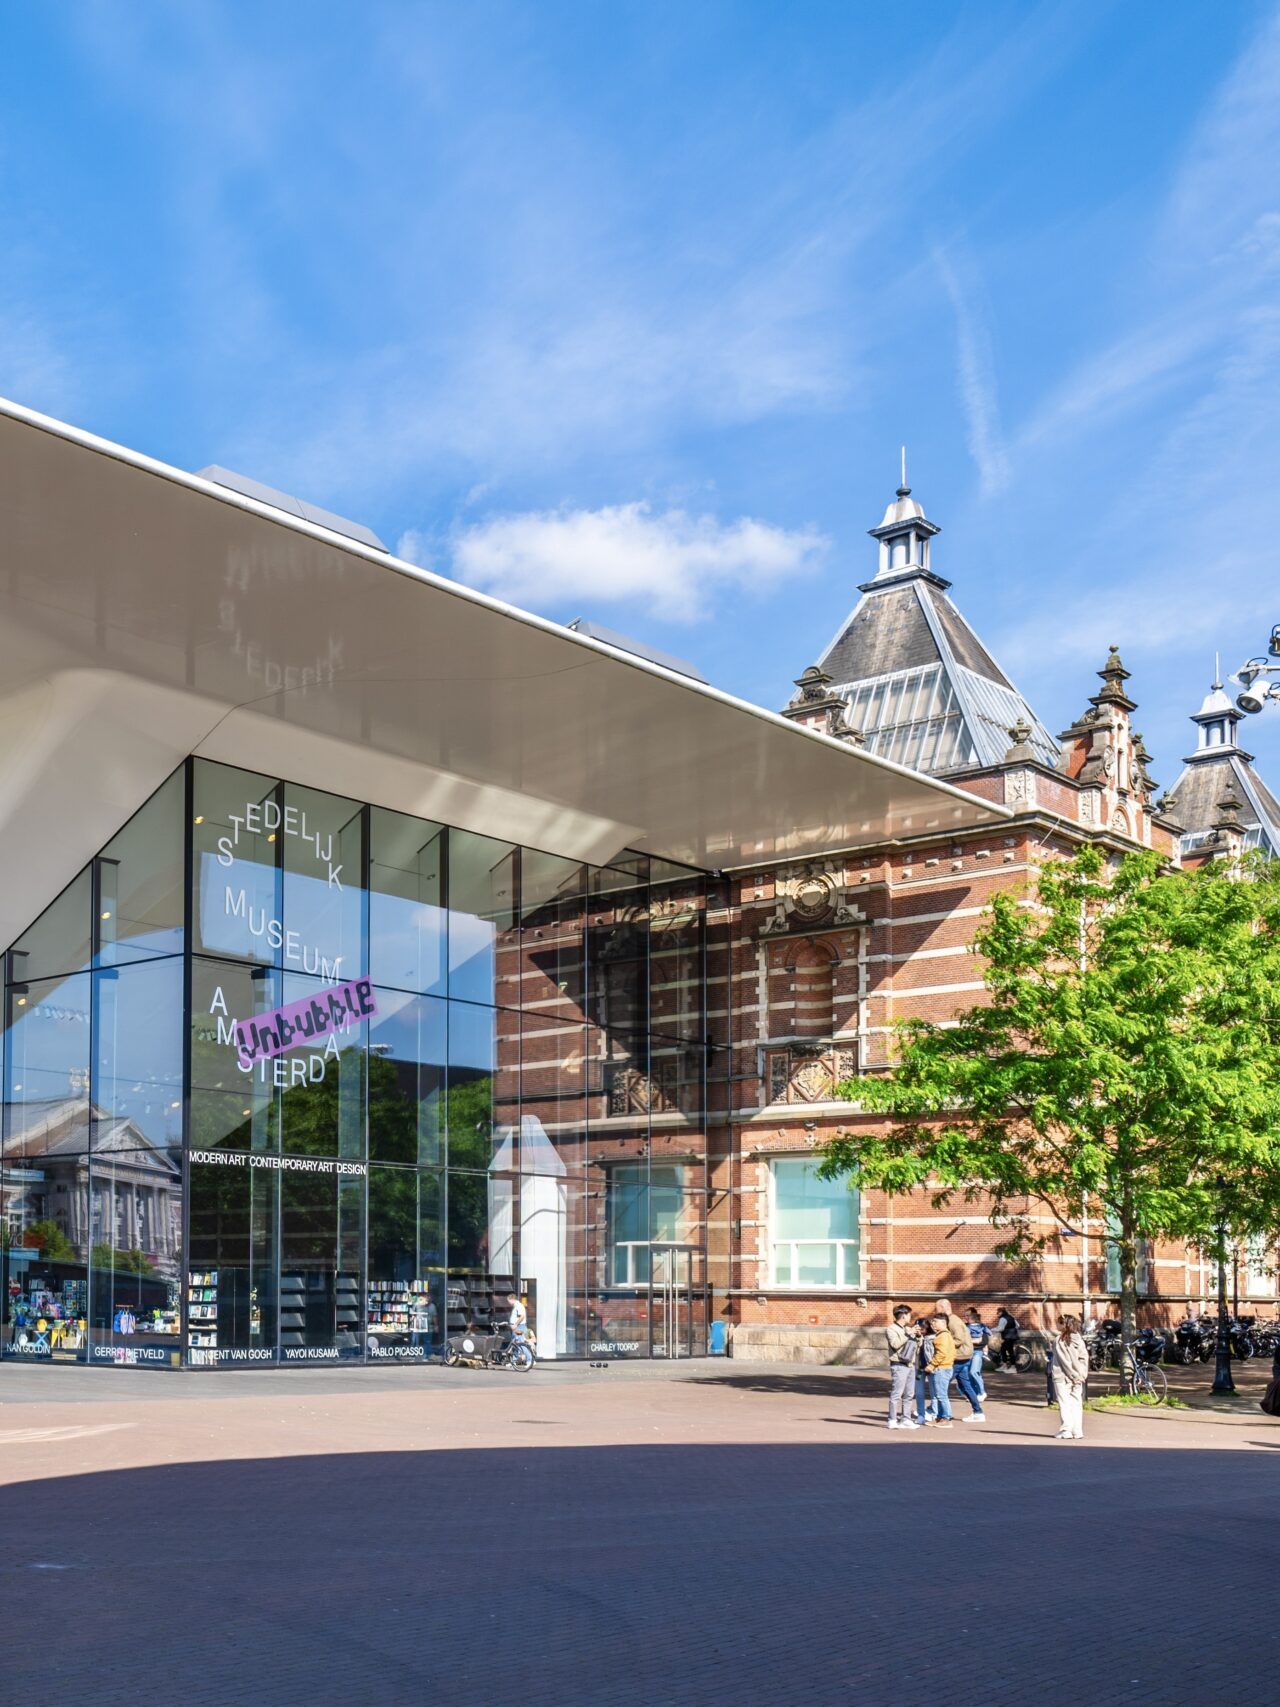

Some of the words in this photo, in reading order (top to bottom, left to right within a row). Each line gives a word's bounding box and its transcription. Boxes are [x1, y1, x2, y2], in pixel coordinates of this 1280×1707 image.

[217, 800, 343, 892] STEDELIJK
[225, 886, 341, 986] MUSEUM
[209, 986, 351, 1088] AMSTERDAM
[189, 1150, 231, 1165] MODERN
[229, 1154, 246, 1166] ART
[249, 1156, 317, 1171] CONTEMPORARY
[318, 1161, 334, 1173] ART
[336, 1162, 367, 1175] DESIGN
[6, 1342, 22, 1353] NAN
[22, 1343, 51, 1354] GOLDIN
[94, 1346, 124, 1358] GERR
[371, 1347, 394, 1357] PABLO
[394, 1346, 424, 1357] PICASSO
[590, 1343, 616, 1352] CHARLEY
[616, 1342, 639, 1351] TOOROP
[193, 1349, 230, 1360] NCENT
[230, 1349, 248, 1360] VAN
[248, 1348, 272, 1360] GOGH
[285, 1348, 307, 1359] YAYOI
[308, 1348, 339, 1359] KUSAMA
